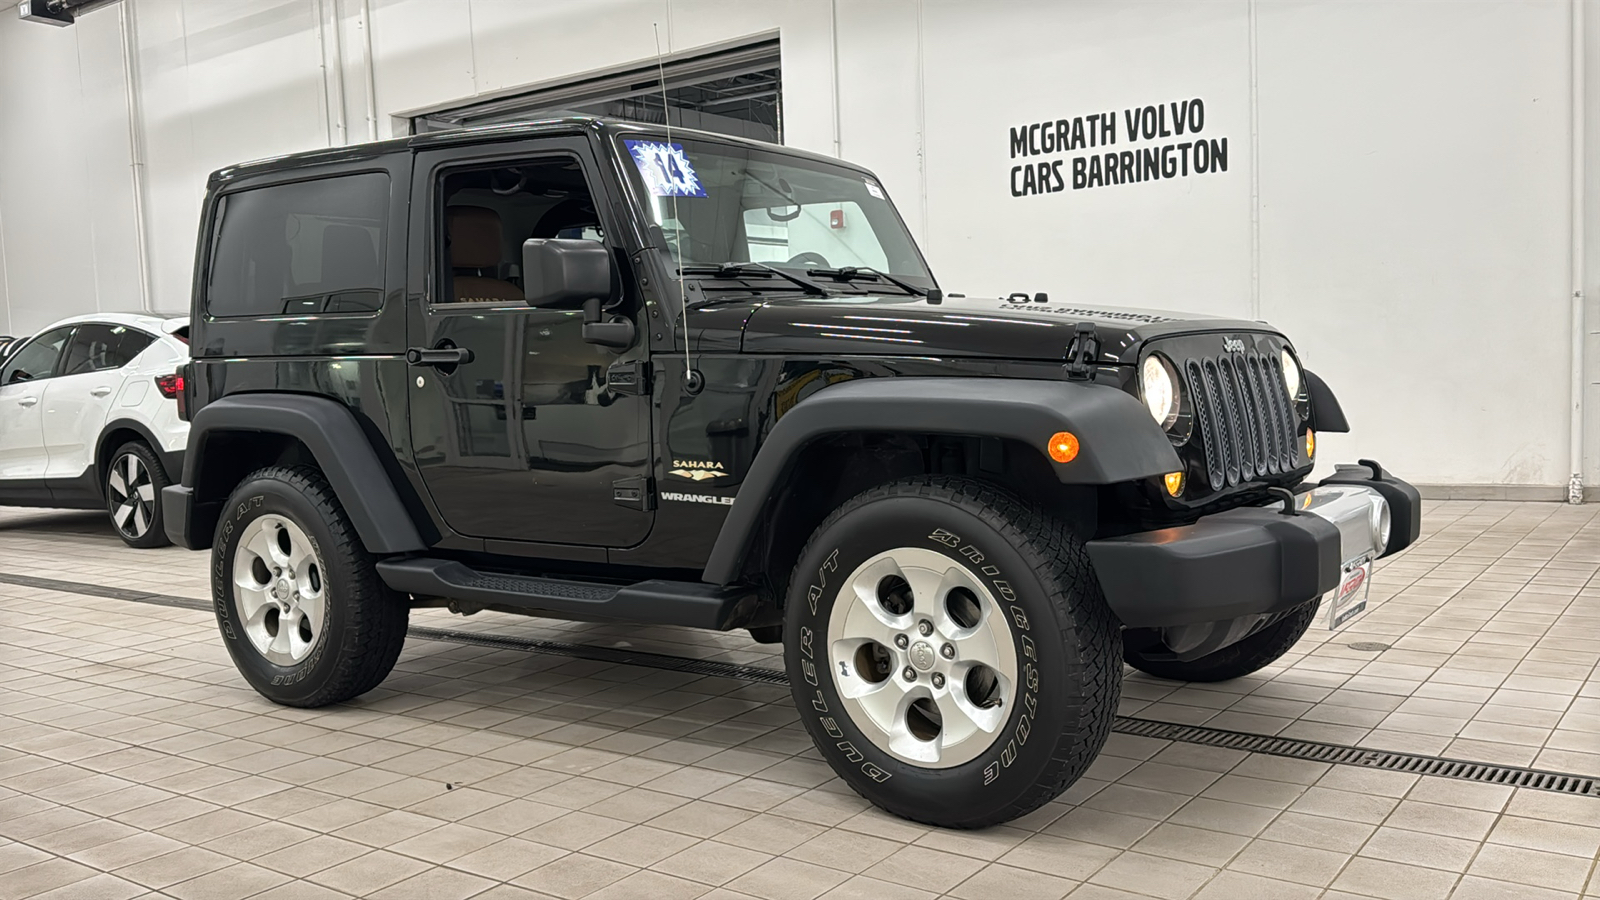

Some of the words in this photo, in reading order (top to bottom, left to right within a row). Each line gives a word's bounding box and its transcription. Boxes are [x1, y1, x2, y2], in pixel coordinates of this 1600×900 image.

[1010, 112, 1116, 158] MCGRATH
[1124, 98, 1204, 142] VOLVO
[654, 152, 686, 184] 14
[1010, 160, 1064, 197] CARS
[1073, 137, 1228, 190] BARRINGTON
[1223, 335, 1245, 354] Jeep
[673, 460, 724, 469] SAHARA
[807, 548, 839, 616] A/T
[927, 527, 1039, 786] BRIDGESTONE
[800, 626, 892, 783] DUELER
